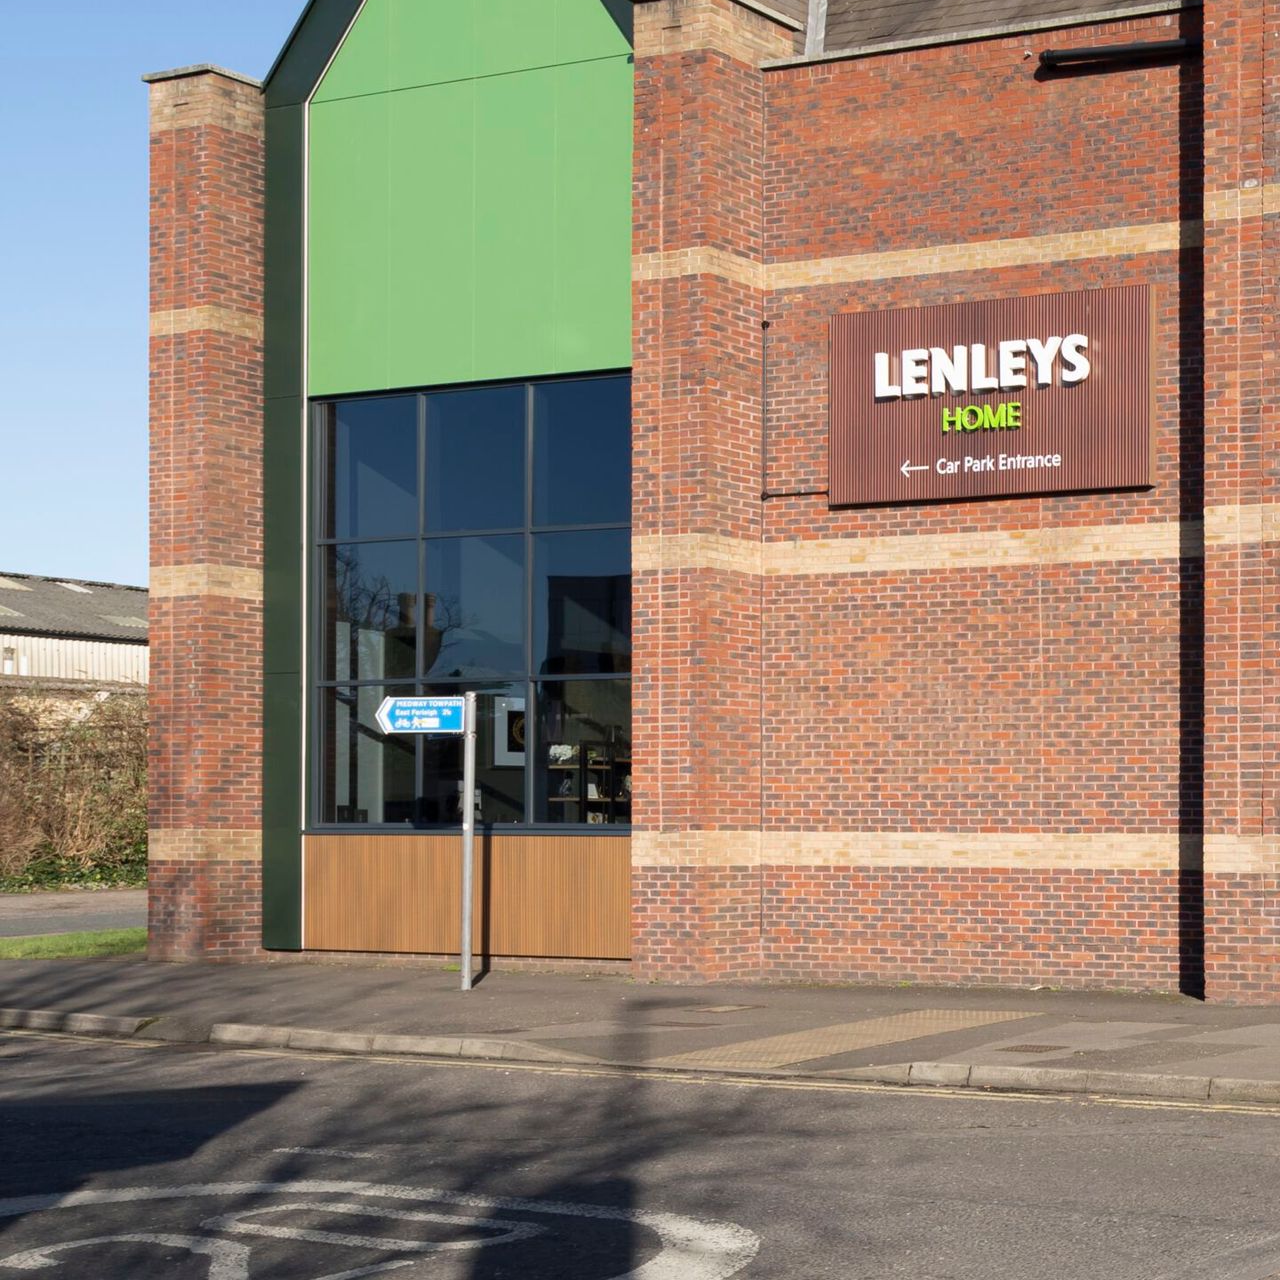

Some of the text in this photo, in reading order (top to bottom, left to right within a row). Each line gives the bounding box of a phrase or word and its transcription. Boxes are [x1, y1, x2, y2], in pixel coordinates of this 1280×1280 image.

[874, 333, 1091, 398] LENLEYS
[942, 401, 1021, 432] HOME
[936, 453, 1062, 475] Car Park Entrance
